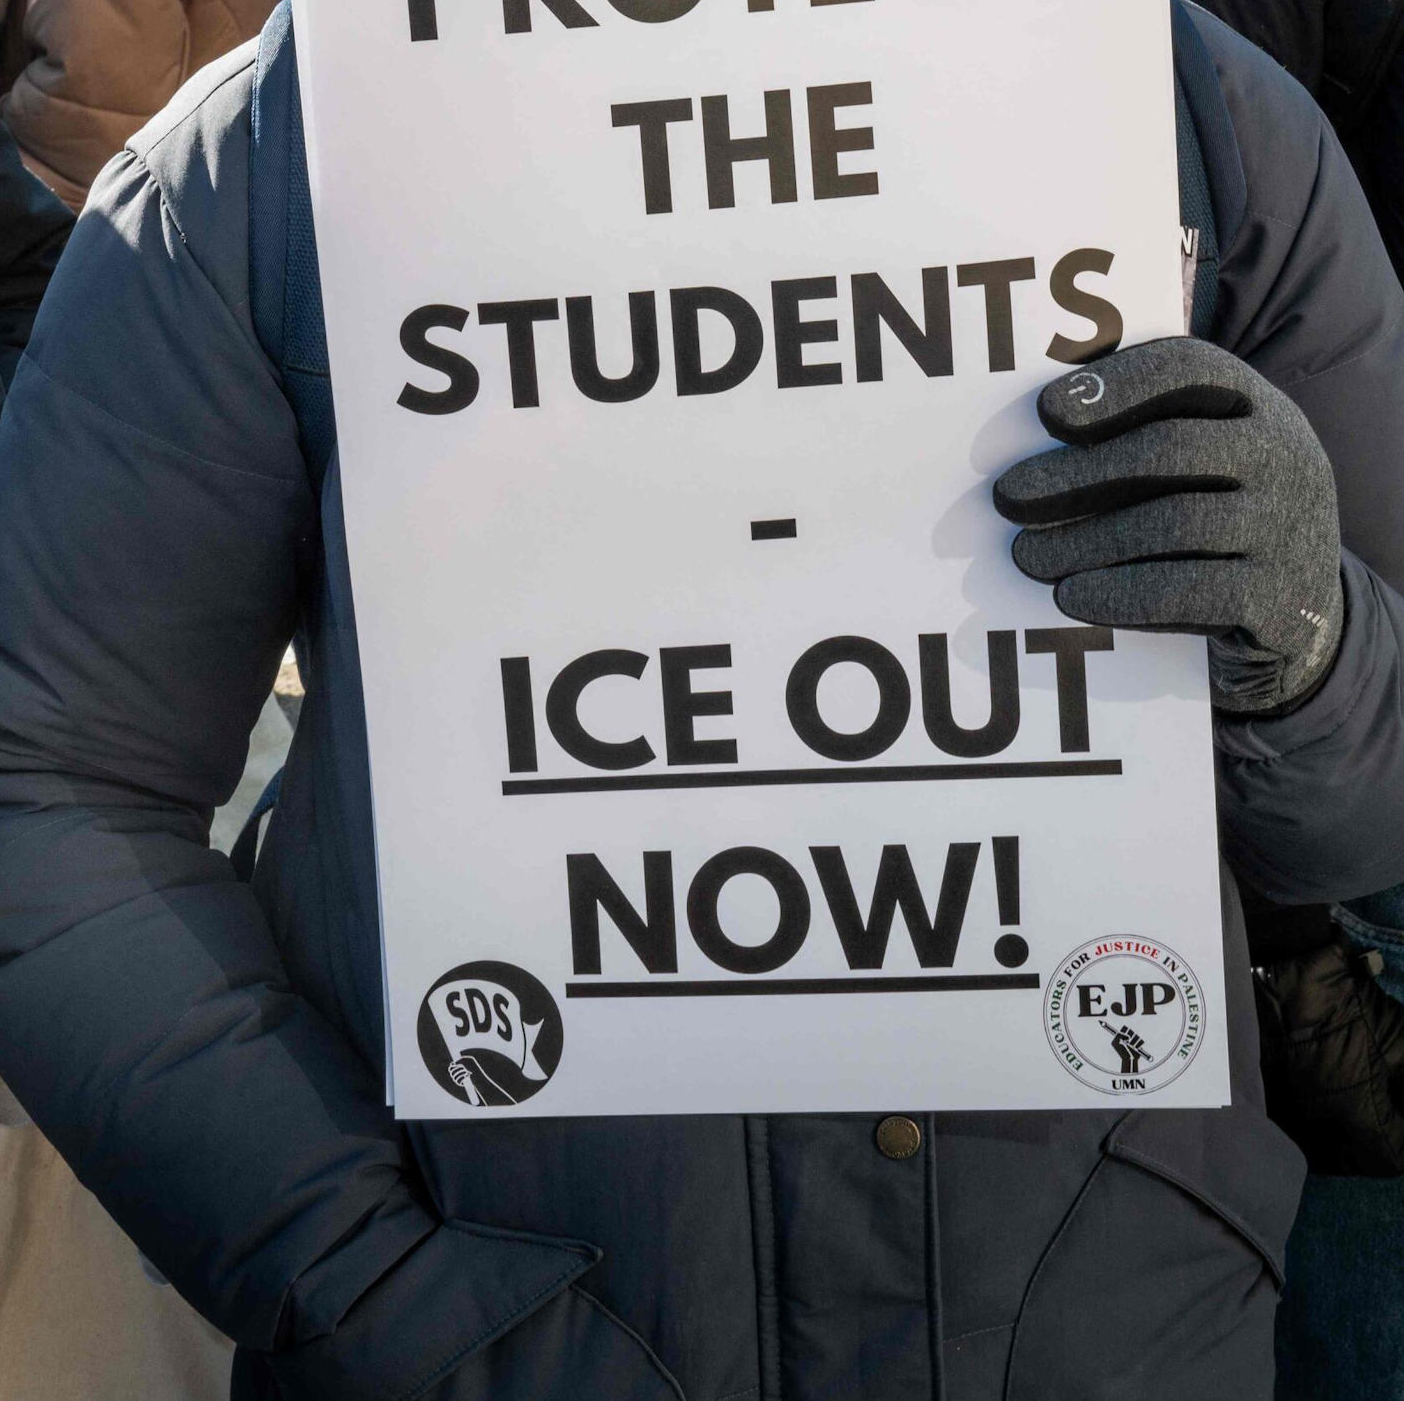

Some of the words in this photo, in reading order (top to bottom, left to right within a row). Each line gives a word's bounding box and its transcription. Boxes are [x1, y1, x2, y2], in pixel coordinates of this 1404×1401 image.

[611, 81, 879, 215] THE
[396, 248, 1124, 416] STUDENTS
[500, 643, 739, 774] ICE
[785, 628, 1115, 762] OUT
[566, 835, 1030, 976] NOW!
[1063, 952, 1091, 978] FOR
[1095, 941, 1161, 960] JUSTICE
[1162, 956, 1180, 974] IN
[445, 987, 513, 1043] SDS
[1050, 979, 1084, 1071] EDUCATORS
[1076, 982, 1176, 1018] EJP
[1177, 972, 1200, 1060] PALESTINE
[1111, 1078, 1146, 1091] UMN
